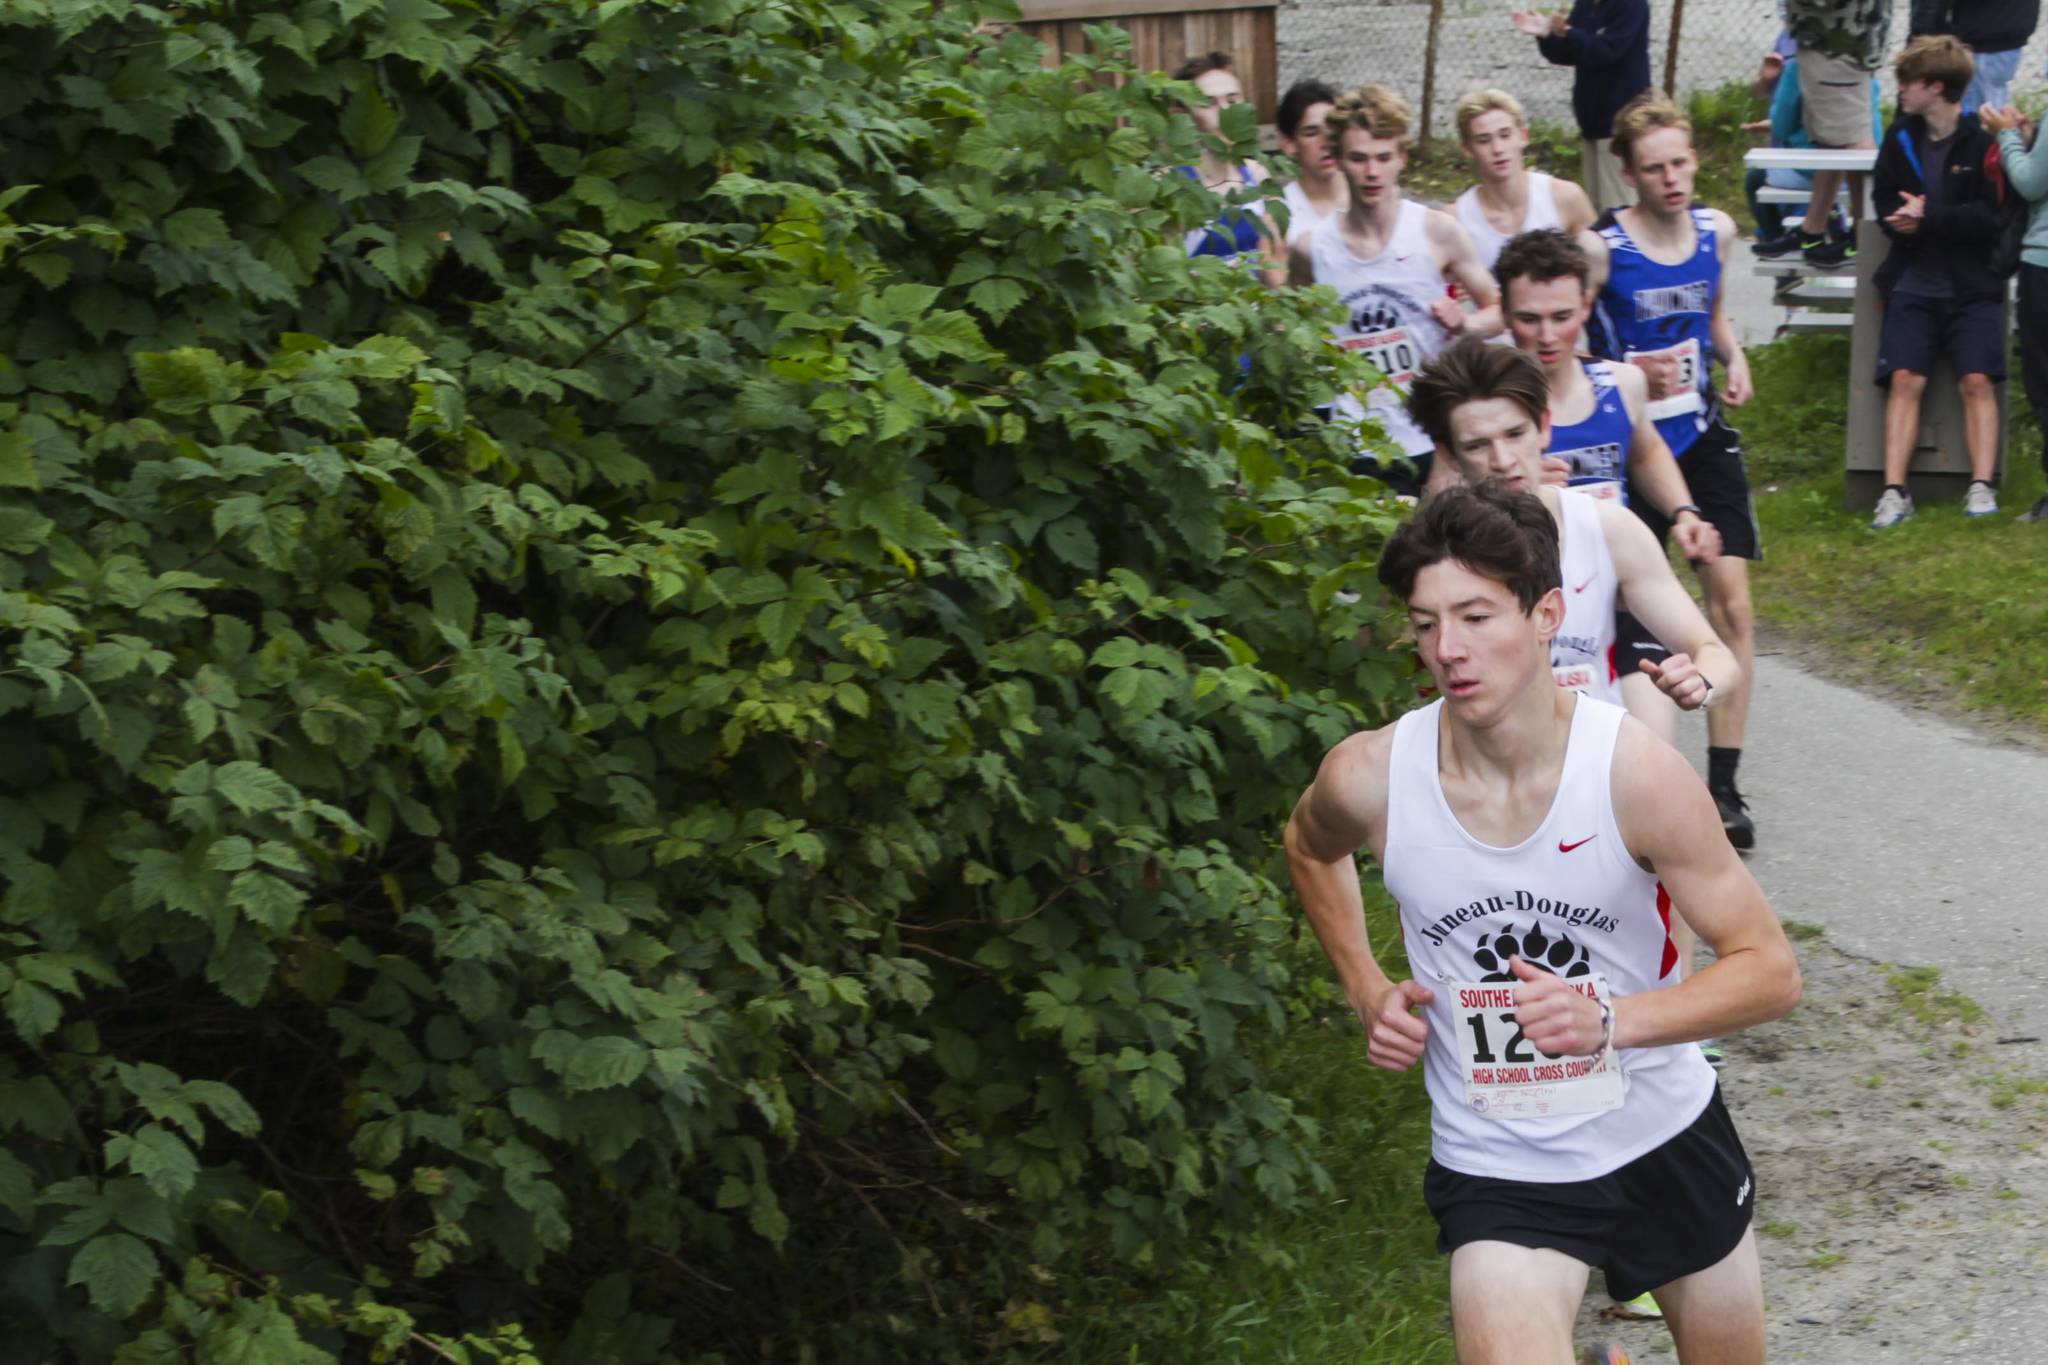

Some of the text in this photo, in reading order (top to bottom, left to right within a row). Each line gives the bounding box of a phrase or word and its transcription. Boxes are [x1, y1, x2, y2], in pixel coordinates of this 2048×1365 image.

[1420, 889, 1619, 947] Juneau-Douglas
[1460, 988, 1520, 1008] SOUTHE
[1467, 1012, 1563, 1063] 12
[1472, 1067, 1494, 1085] HIGH
[1496, 1065, 1532, 1083] SCHOOL
[1533, 1062, 1564, 1081] CROSS
